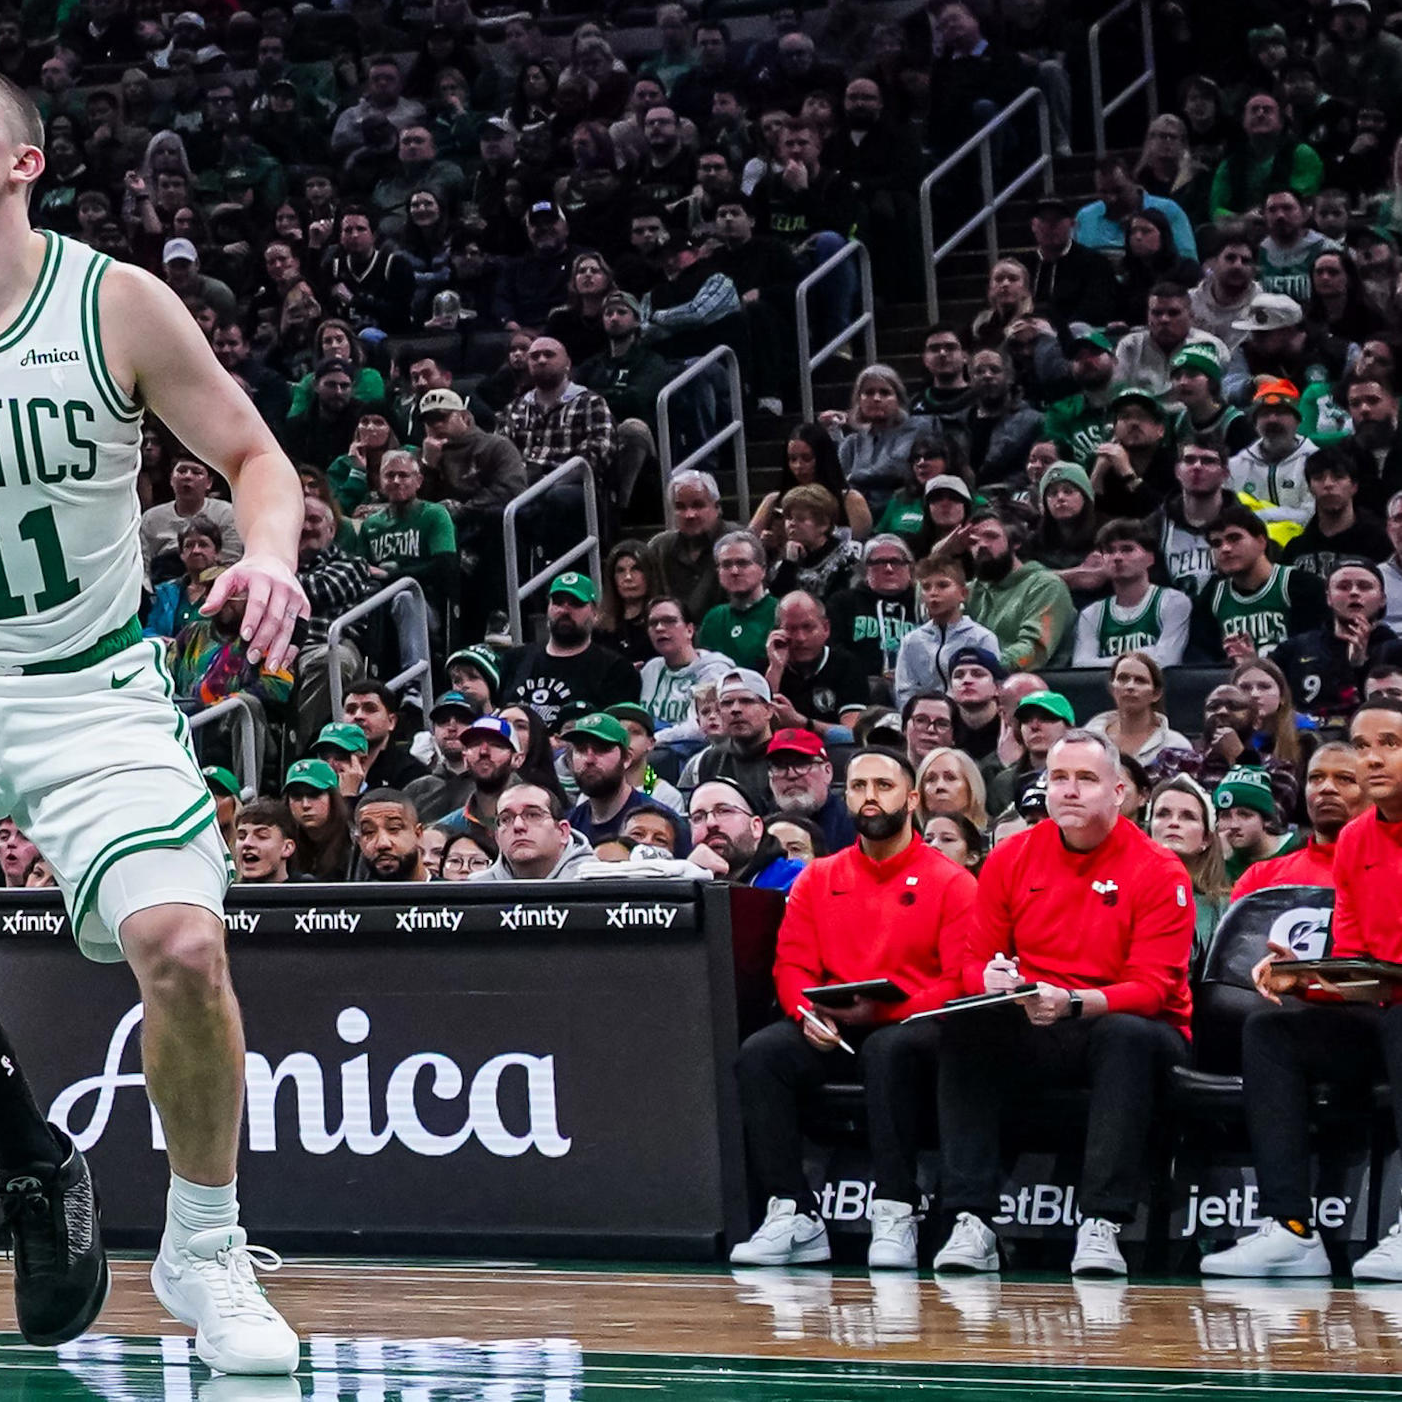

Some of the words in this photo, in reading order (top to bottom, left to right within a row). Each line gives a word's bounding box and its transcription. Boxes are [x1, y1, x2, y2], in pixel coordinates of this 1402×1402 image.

[21, 347, 80, 367] Amica
[1302, 675, 1322, 703] 9
[3, 910, 65, 935] xfinity
[295, 908, 361, 934] xfinity
[396, 907, 464, 932] xfinity
[499, 903, 569, 930] xfinity
[605, 901, 678, 930] xfinity
